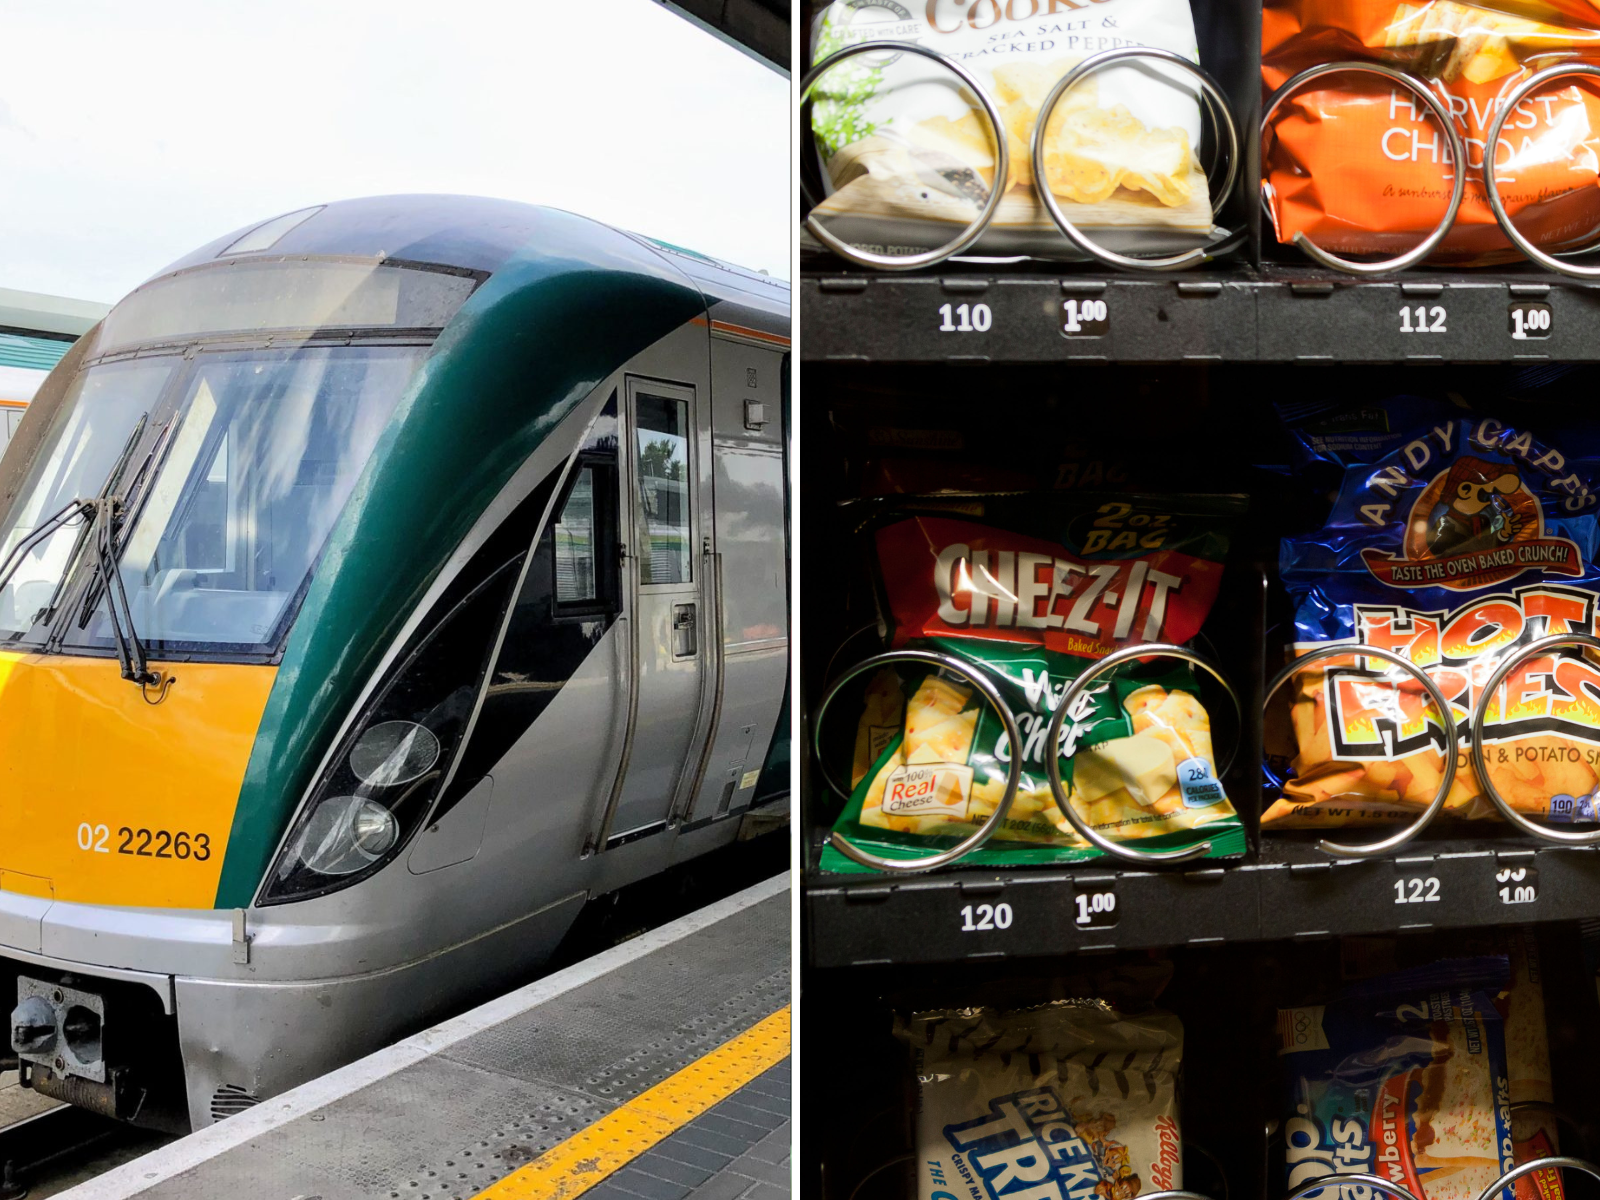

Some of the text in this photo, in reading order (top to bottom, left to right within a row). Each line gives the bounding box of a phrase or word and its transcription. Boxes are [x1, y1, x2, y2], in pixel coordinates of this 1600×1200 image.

[896, 23, 919, 36] CARE
[925, 0, 1113, 34] COOK
[987, 15, 1119, 44] SEA SALT &
[947, 40, 1056, 62] CRACKED
[1381, 127, 1576, 170] CHEDDA
[939, 304, 992, 332] 110
[1063, 300, 1107, 332] 1.00
[1399, 306, 1447, 332] 112
[1511, 309, 1551, 339] 1.00
[1360, 420, 1454, 526] ANDY
[1093, 501, 1133, 530] 2
[1080, 529, 1172, 556] BAG
[1390, 545, 1569, 581] TASTE THE OVEN BAKED CRUNCH!
[934, 543, 1182, 643] CHEEZ-IT
[1356, 588, 1597, 674] HOT
[1067, 637, 1094, 654] Baked
[1443, 750, 1491, 768] ON
[1497, 747, 1510, 763] &
[1515, 746, 1581, 763] POTATO
[891, 775, 936, 801] Real
[1185, 783, 1219, 796] CALORIES
[890, 795, 933, 812] Cheese
[1291, 804, 1322, 817] NET
[1328, 808, 1351, 818] WT
[1552, 799, 1573, 815] 190
[77, 822, 211, 862] 02 22263
[1393, 876, 1441, 904] 122
[960, 903, 1014, 932] 120
[1075, 892, 1116, 924] 1.00
[1396, 1000, 1430, 1024] 2
[1441, 991, 1455, 1023] PASTRIES
[1467, 1028, 1479, 1040] WT
[1468, 1038, 1481, 1054] NET
[1018, 1092, 1090, 1162] RICE
[926, 1160, 947, 1186] THE
[951, 1153, 975, 1185] CRISPY
